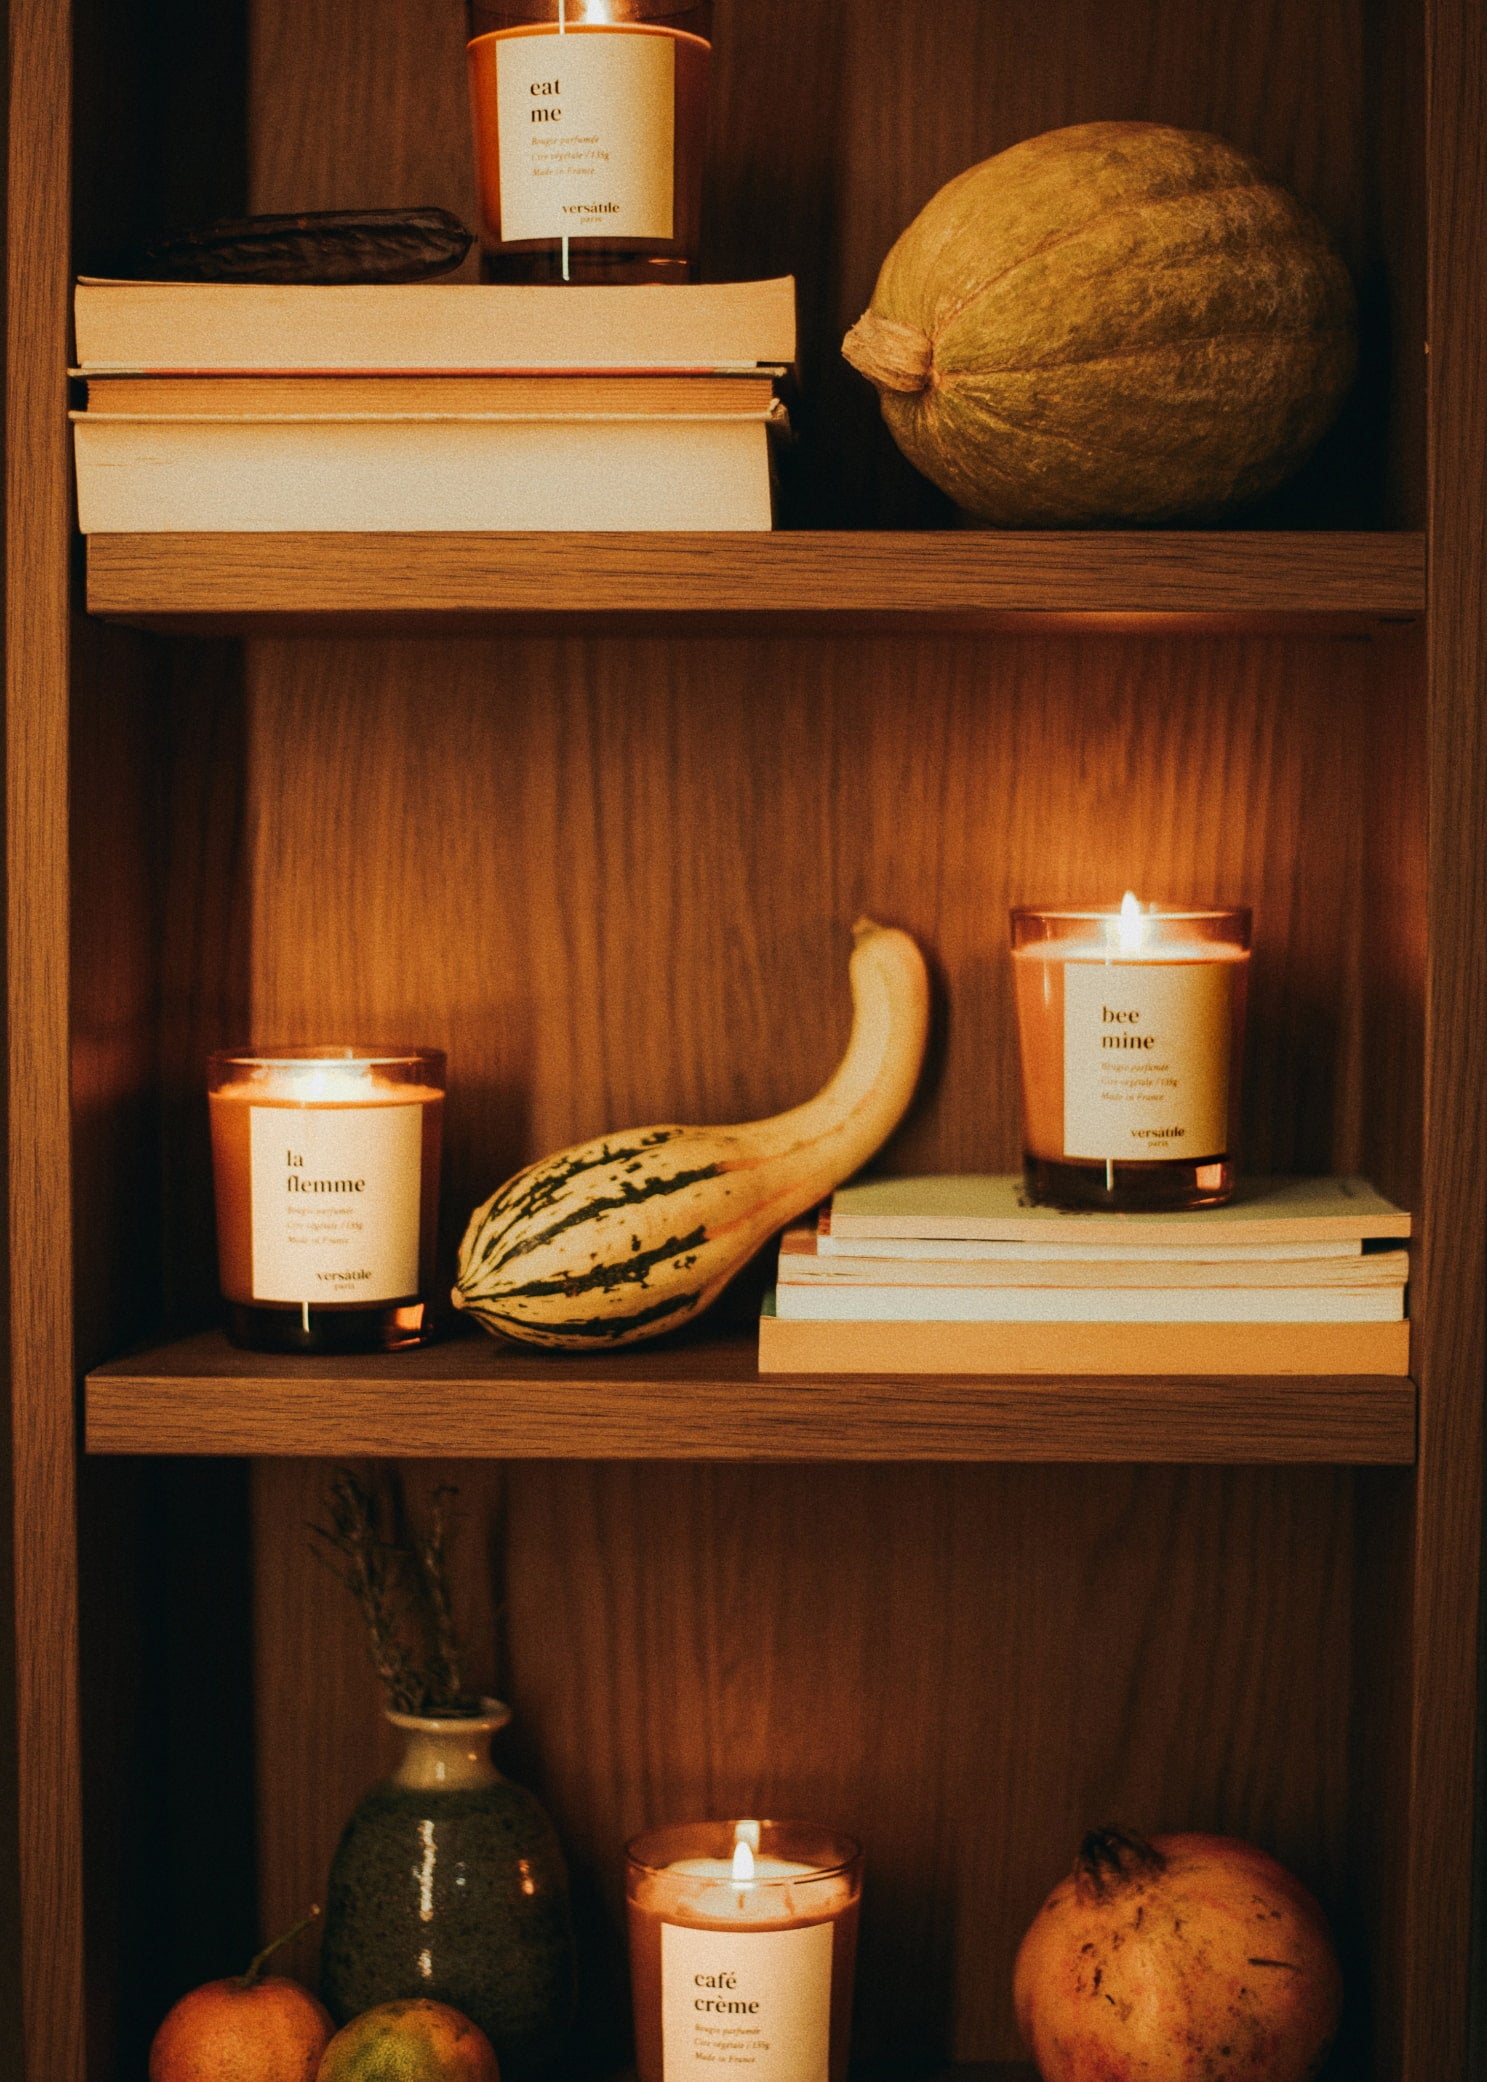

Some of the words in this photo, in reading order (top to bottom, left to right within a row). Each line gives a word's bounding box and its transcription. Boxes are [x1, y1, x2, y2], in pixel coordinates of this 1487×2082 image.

[530, 79, 561, 96] eat
[531, 108, 562, 122] me
[1102, 1005, 1140, 1024] bee
[1102, 1031, 1154, 1049] mine
[287, 1150, 304, 1167] la
[287, 1175, 366, 1193] flemme
[694, 1971, 737, 1989] café
[694, 1996, 760, 2014] crème
